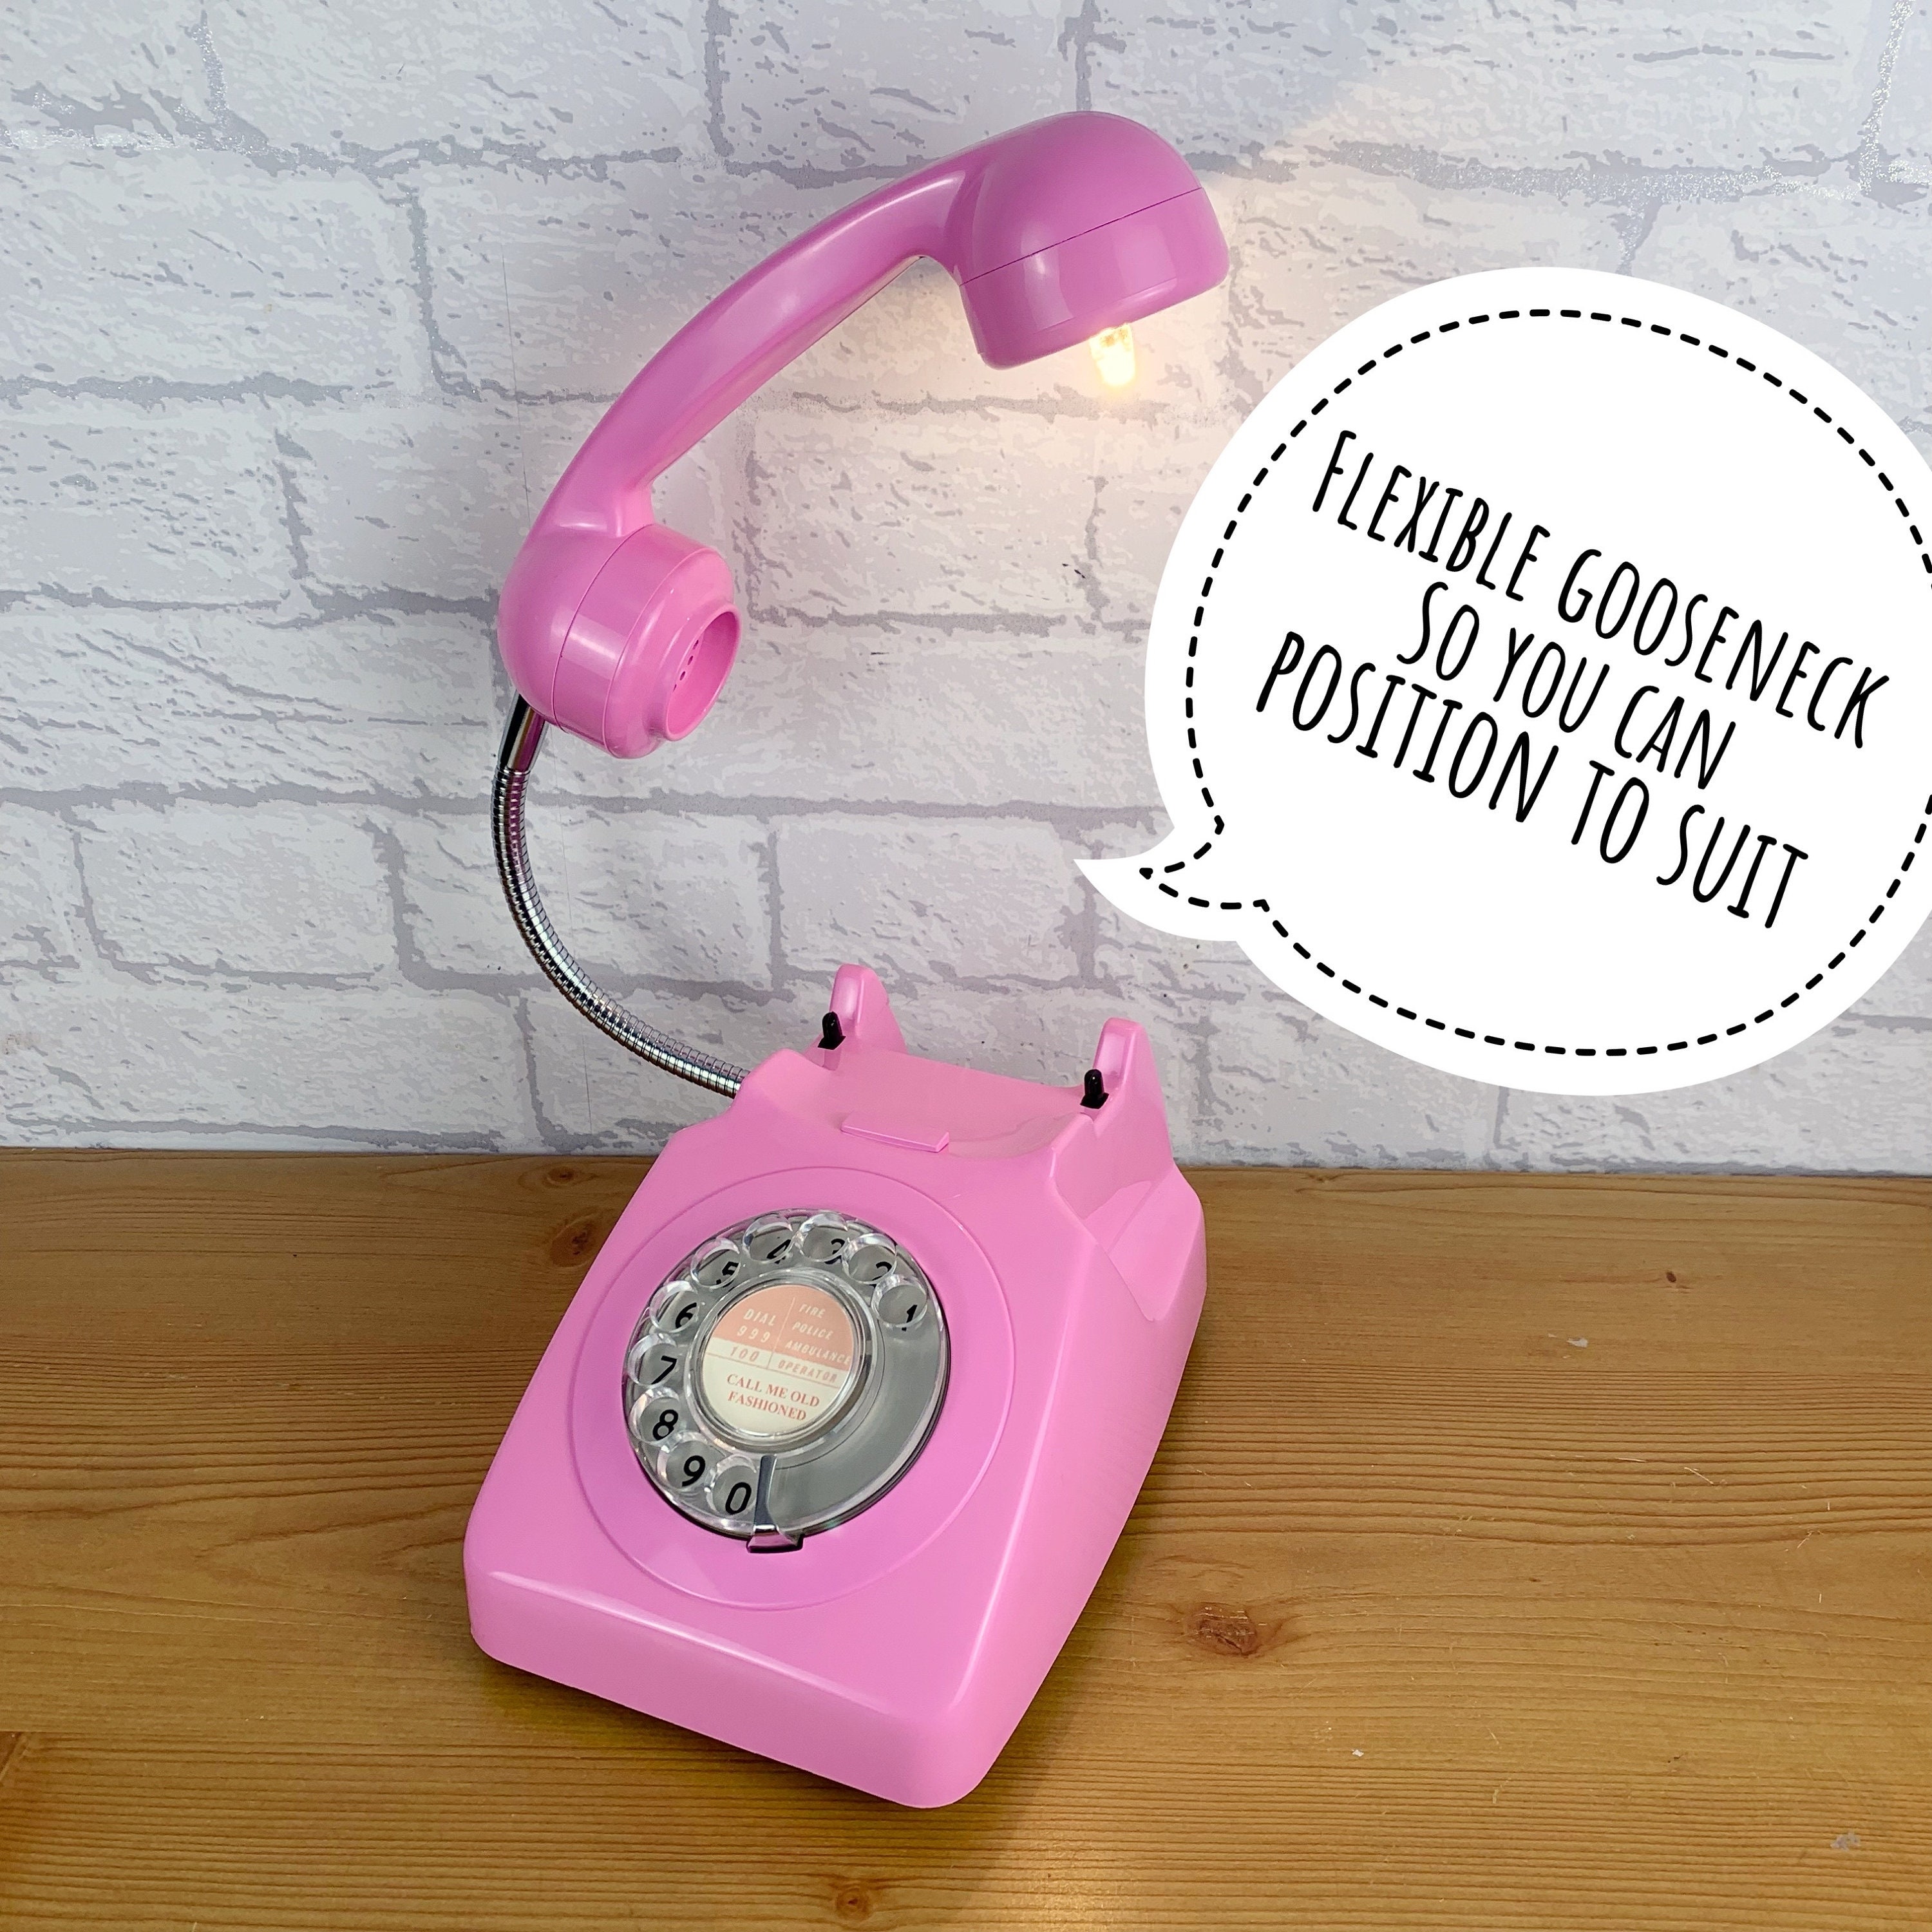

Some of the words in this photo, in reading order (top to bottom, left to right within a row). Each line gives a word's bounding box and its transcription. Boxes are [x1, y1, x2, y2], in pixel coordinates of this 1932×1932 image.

[676, 1302, 697, 1329] 6
[743, 1308, 775, 1326] DIAL
[799, 1303, 826, 1318] FIRE
[902, 1305, 917, 1331] 1
[737, 1325, 771, 1343] 999
[792, 1321, 834, 1340] POLICE
[730, 1346, 760, 1362] 100
[785, 1340, 851, 1366] AMBULANCE
[651, 1355, 677, 1385] 7
[778, 1359, 838, 1383] OPERATOR
[727, 1373, 762, 1392] CALL
[765, 1384, 788, 1398] ME
[791, 1392, 820, 1408] OLD
[728, 1390, 806, 1421] FASHIONED
[653, 1409, 678, 1441] 8
[682, 1455, 705, 1486] 9
[725, 1482, 752, 1514] 0
